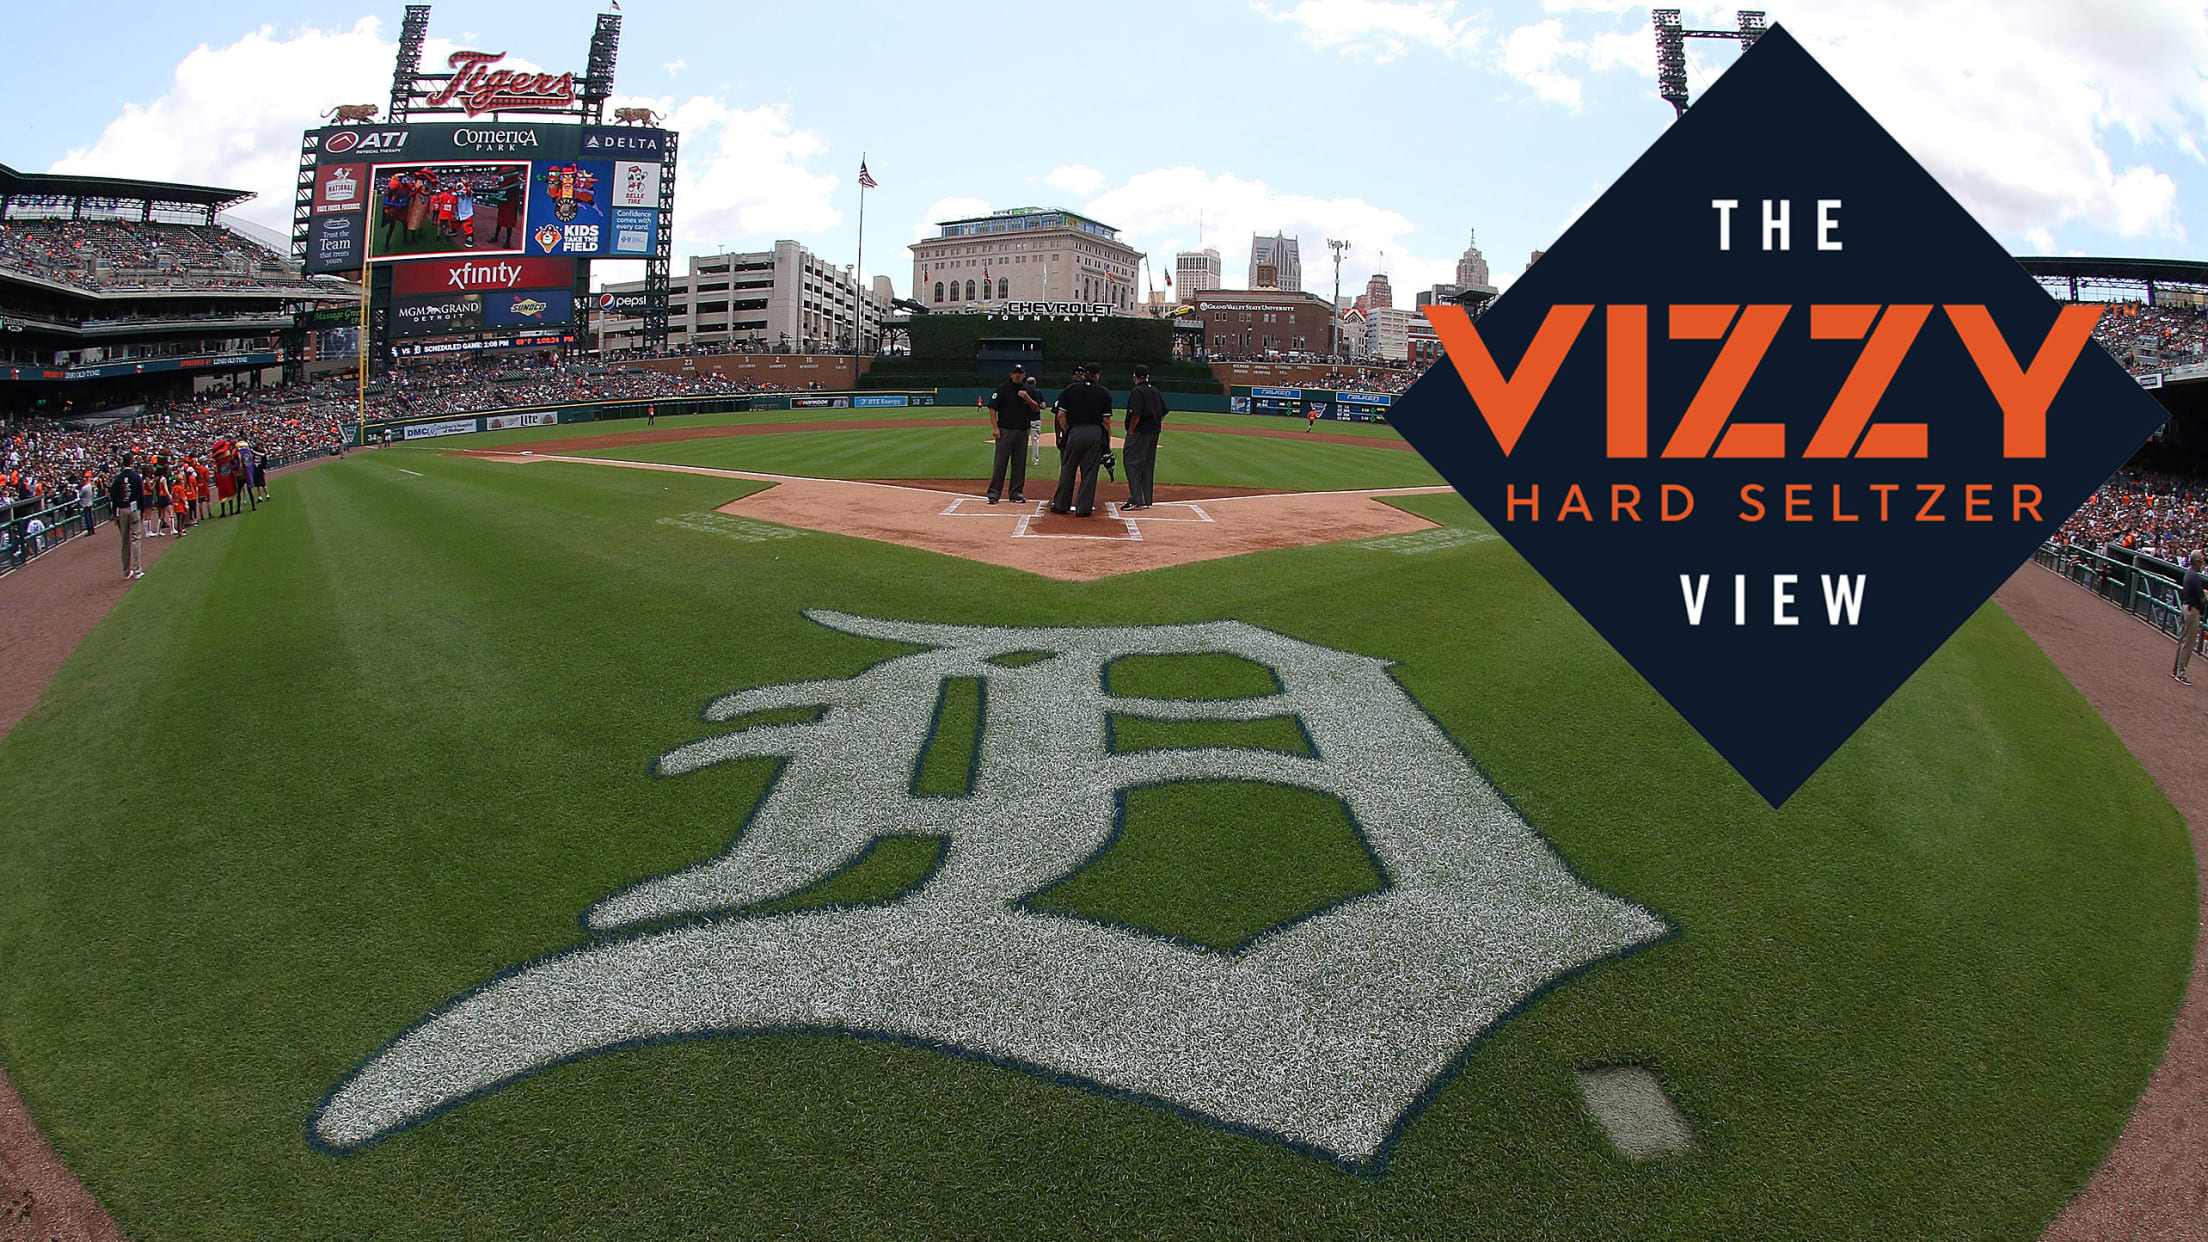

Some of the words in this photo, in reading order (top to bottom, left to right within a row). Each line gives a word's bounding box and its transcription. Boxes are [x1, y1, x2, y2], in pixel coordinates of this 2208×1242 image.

[426, 50, 576, 119] Tigers
[357, 131, 409, 148] ATI
[604, 136, 657, 150] DELTA
[327, 183, 353, 193] NATIONAL
[564, 225, 599, 237] KIDS
[320, 238, 351, 251] Team
[564, 236, 583, 244] TAKE
[563, 243, 599, 252] FIELD
[325, 257, 343, 266] yours
[448, 261, 523, 290] xfinity
[512, 302, 547, 312] SUNOCO
[616, 295, 646, 308] pepsi
[398, 307, 425, 317] MGM
[441, 303, 479, 314] GRAND
[1007, 301, 1117, 316] CHEVROLET
[413, 313, 465, 322] DETROIT
[987, 315, 1099, 323] FOUNTAIN
[424, 343, 462, 352] SCHEDULED
[520, 414, 538, 426] Lite
[407, 427, 429, 437] DMC
